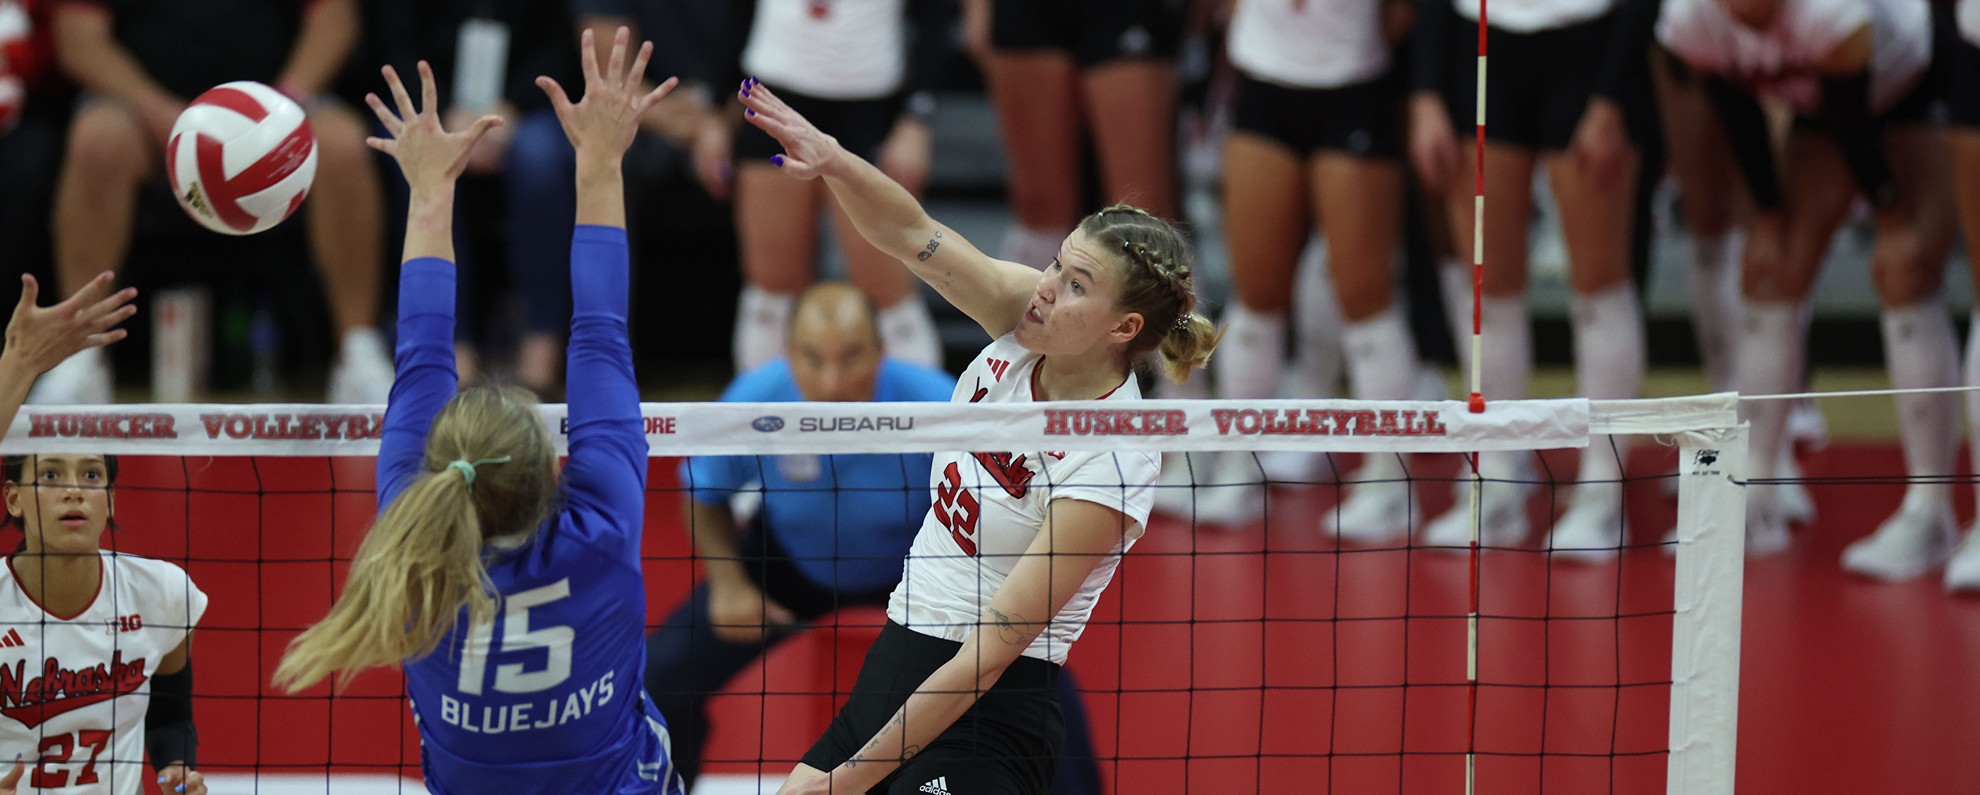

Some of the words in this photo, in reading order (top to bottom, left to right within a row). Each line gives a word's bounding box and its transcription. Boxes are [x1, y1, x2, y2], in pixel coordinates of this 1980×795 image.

[28, 413, 178, 439] HUSKER
[200, 413, 388, 440] VOLLEYBA
[799, 416, 915, 432] SUBARU
[1044, 409, 1189, 436] HUSKER
[1210, 408, 1447, 437] VOLLEYBALL
[932, 461, 980, 558] 22
[457, 576, 576, 697] 15
[0, 649, 148, 709] Nebraska
[441, 669, 615, 735] BLUEJAYS
[30, 728, 116, 789] 27
